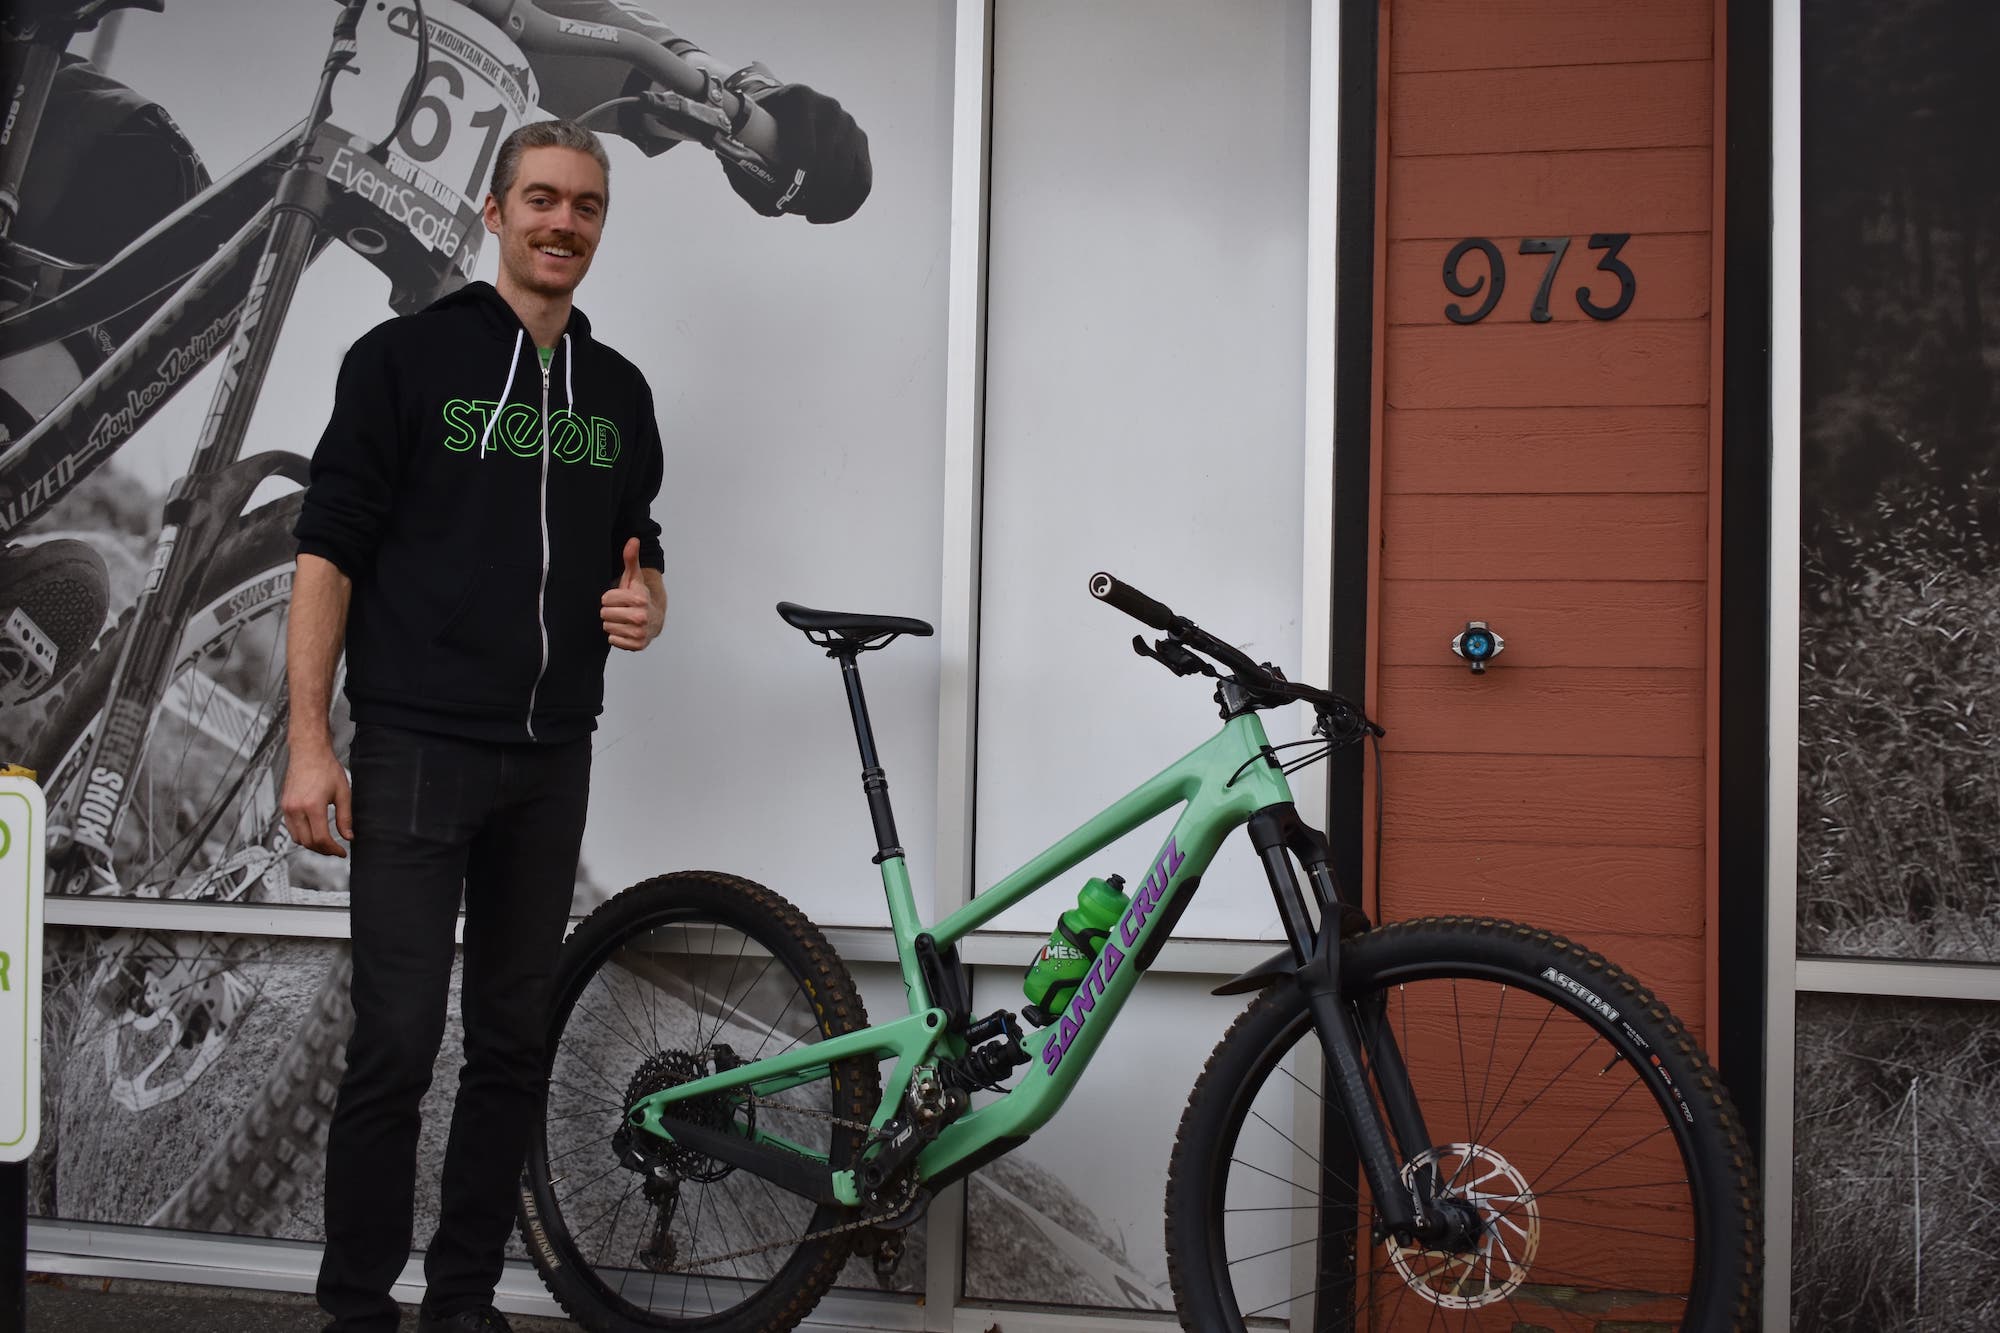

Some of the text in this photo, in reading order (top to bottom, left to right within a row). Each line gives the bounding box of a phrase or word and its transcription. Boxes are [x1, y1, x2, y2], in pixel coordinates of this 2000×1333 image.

[436, 29, 483, 65] MOUNTAIN
[481, 59, 501, 82] BIKE
[398, 61, 507, 203] 61
[1442, 233, 1636, 325] 973
[88, 413, 133, 449] Troy
[128, 390, 166, 418] Lee
[157, 318, 232, 385] Designs
[1042, 835, 1186, 1077] SANTA CRUZ
[1541, 966, 1620, 1023] ASSEGAI
[531, 1218, 561, 1272] MINION
